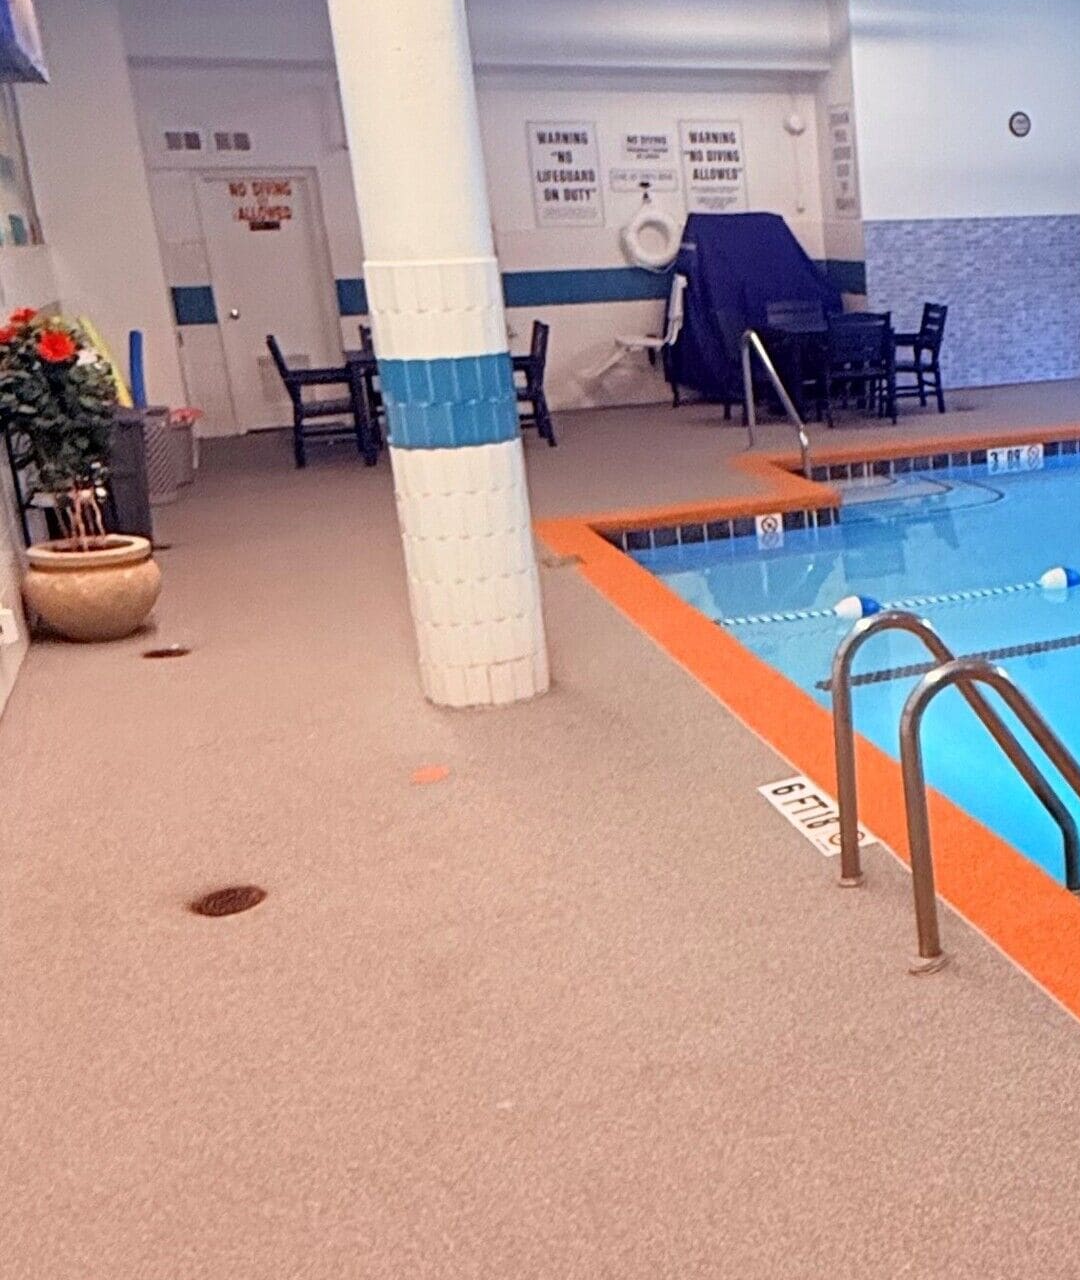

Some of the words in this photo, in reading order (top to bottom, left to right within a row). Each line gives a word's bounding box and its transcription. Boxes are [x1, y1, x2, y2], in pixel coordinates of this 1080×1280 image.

[537, 131, 588, 144] WARNING
[689, 131, 736, 143] WARNING
[707, 150, 739, 162] DIVING
[537, 169, 595, 182] LIFEGUARD
[544, 188, 559, 201] ON
[771, 783, 806, 795] 6
